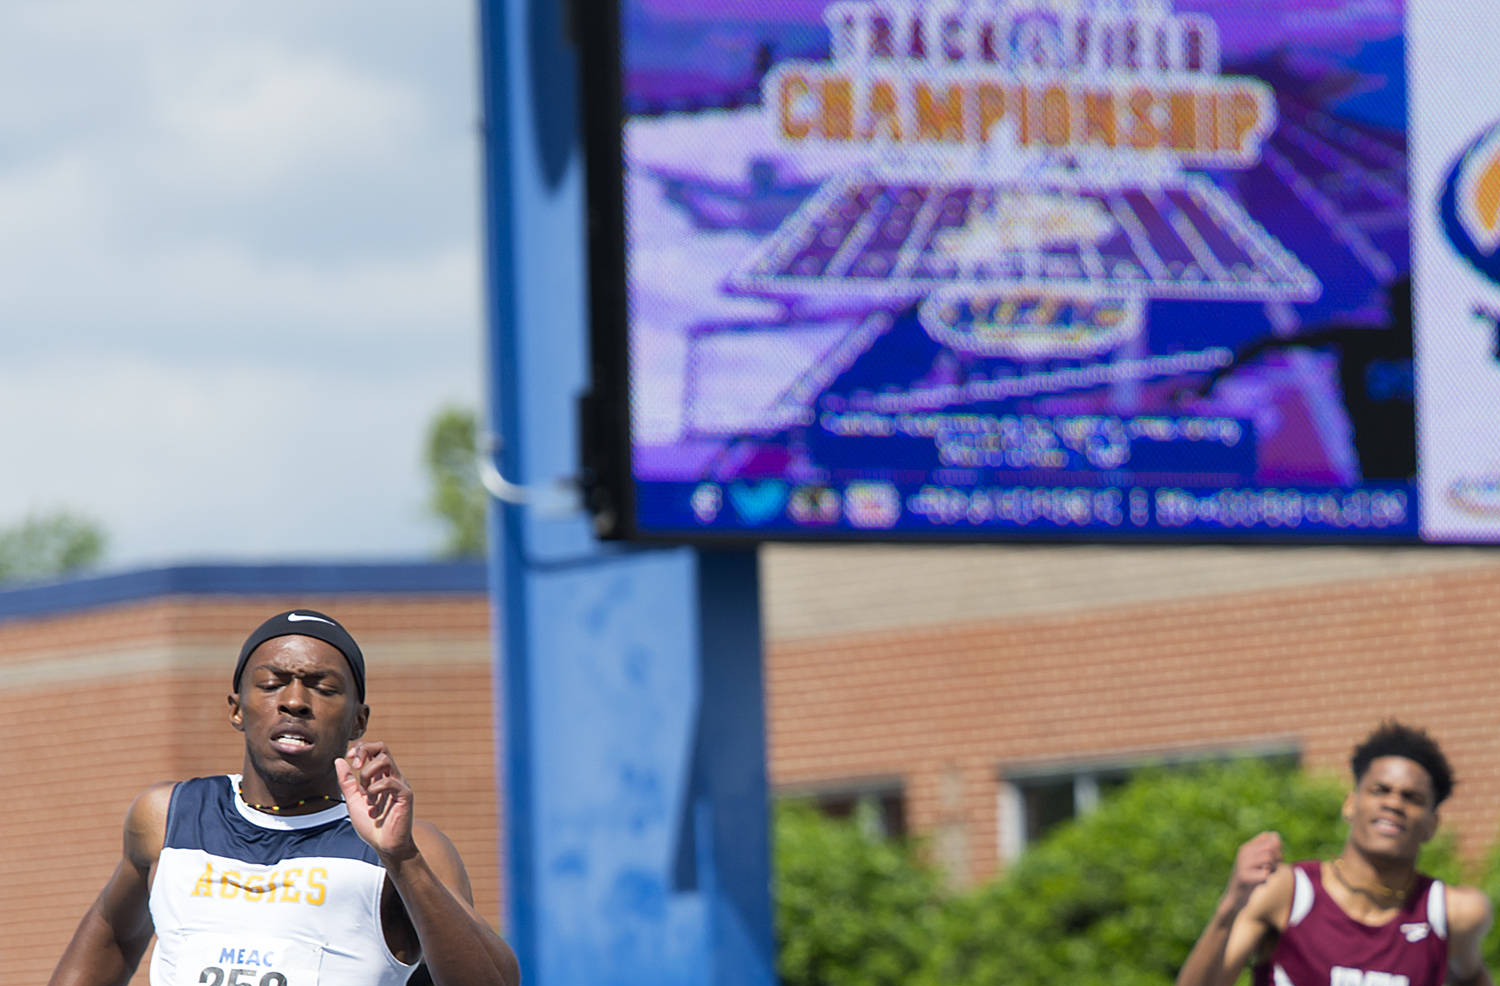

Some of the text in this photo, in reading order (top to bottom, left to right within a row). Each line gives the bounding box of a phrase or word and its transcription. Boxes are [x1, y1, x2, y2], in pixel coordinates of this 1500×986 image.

[780, 75, 1260, 152] CHAMPIONSHIP
[190, 861, 329, 906] AGGIES
[218, 946, 275, 968] MEAC
